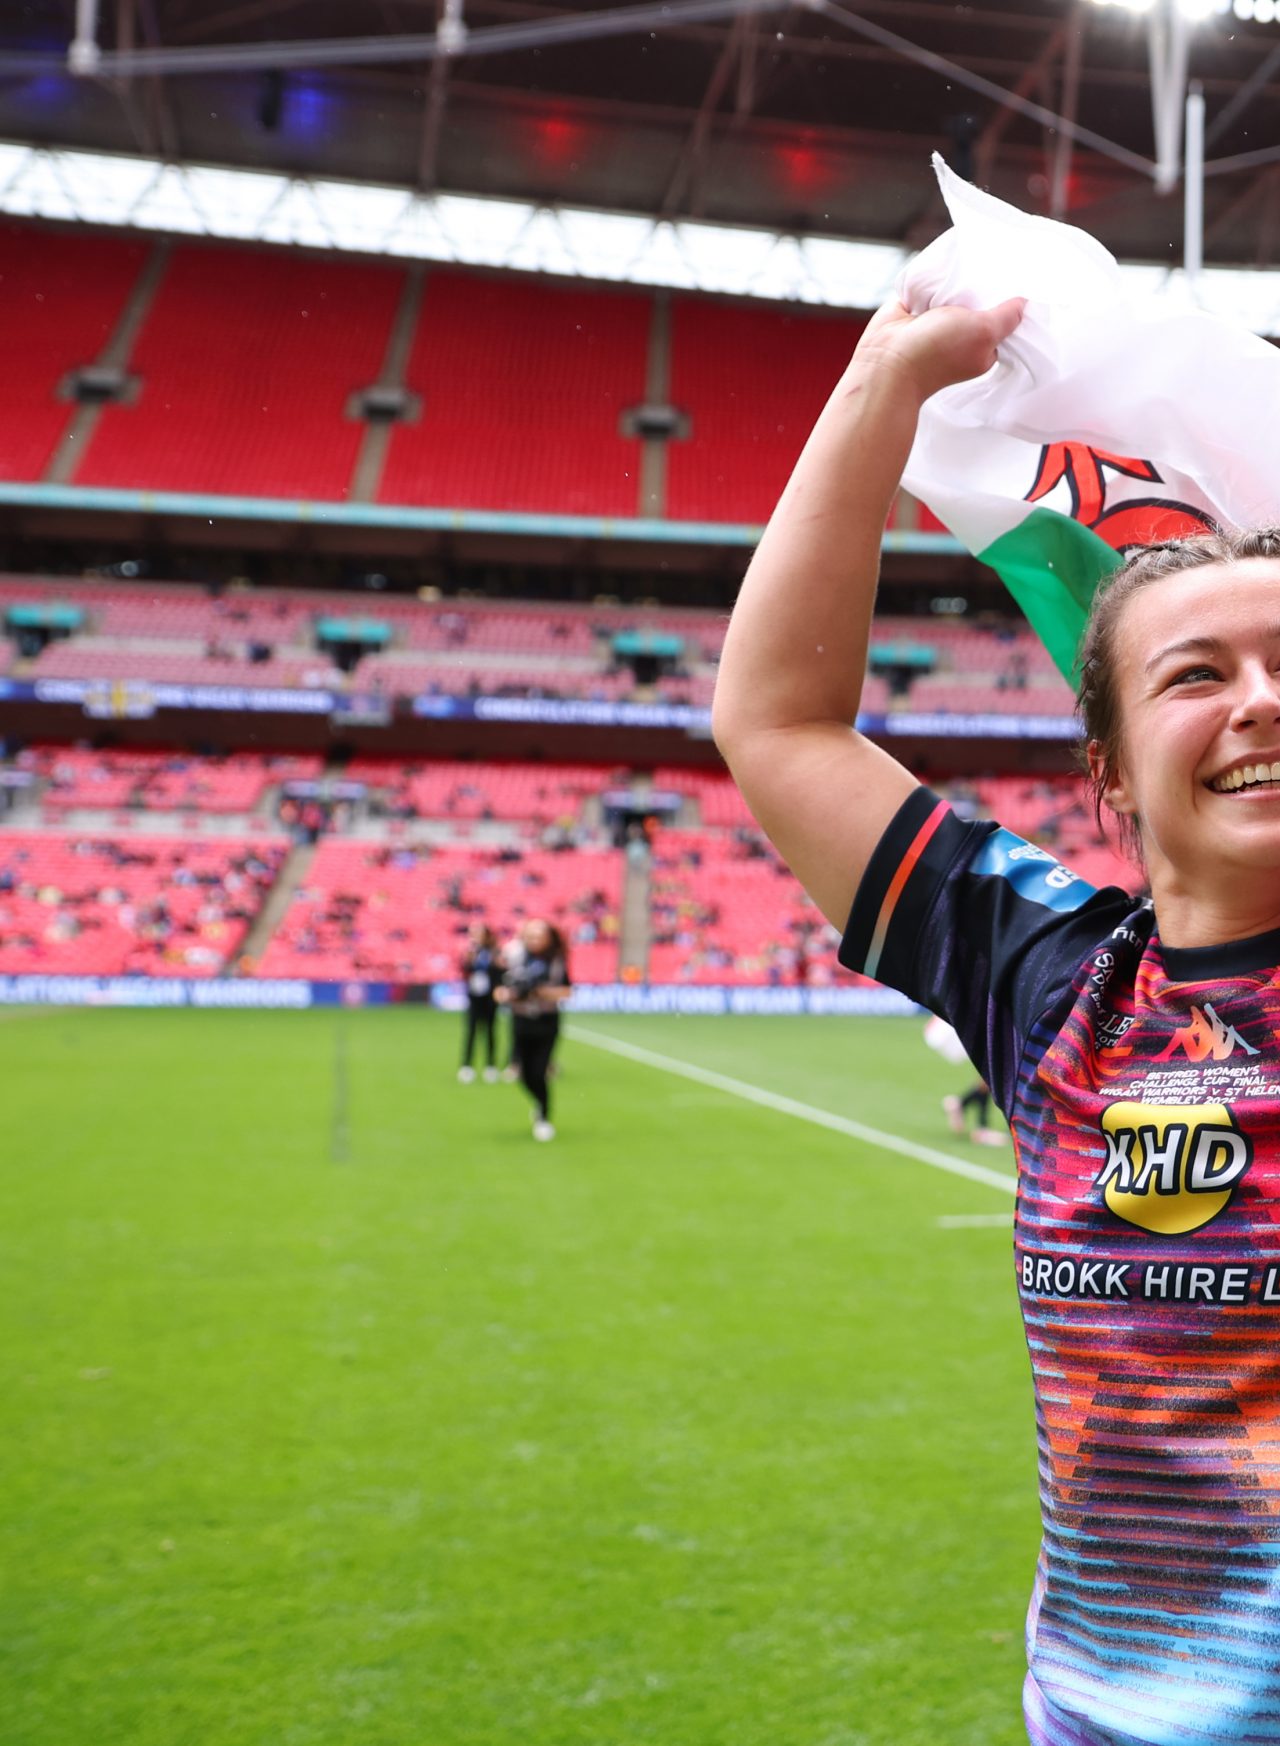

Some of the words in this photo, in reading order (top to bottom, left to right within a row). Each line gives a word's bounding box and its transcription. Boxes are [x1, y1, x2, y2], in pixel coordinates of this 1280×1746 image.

[1146, 1070, 1200, 1080] BETFRED
[1203, 1065, 1260, 1077] WOMEN'S
[1130, 1078, 1200, 1089] CHALLENGE
[1202, 1076, 1231, 1086] CUP
[1233, 1075, 1267, 1087] FINAL
[1099, 1087, 1141, 1097] WIGAN
[1142, 1086, 1208, 1097] WARRIORS
[1224, 1087, 1243, 1096] ST
[1141, 1096, 1202, 1105] WEMBLEY
[1022, 1255, 1130, 1296] BROKK
[1144, 1265, 1249, 1301] HIRE
